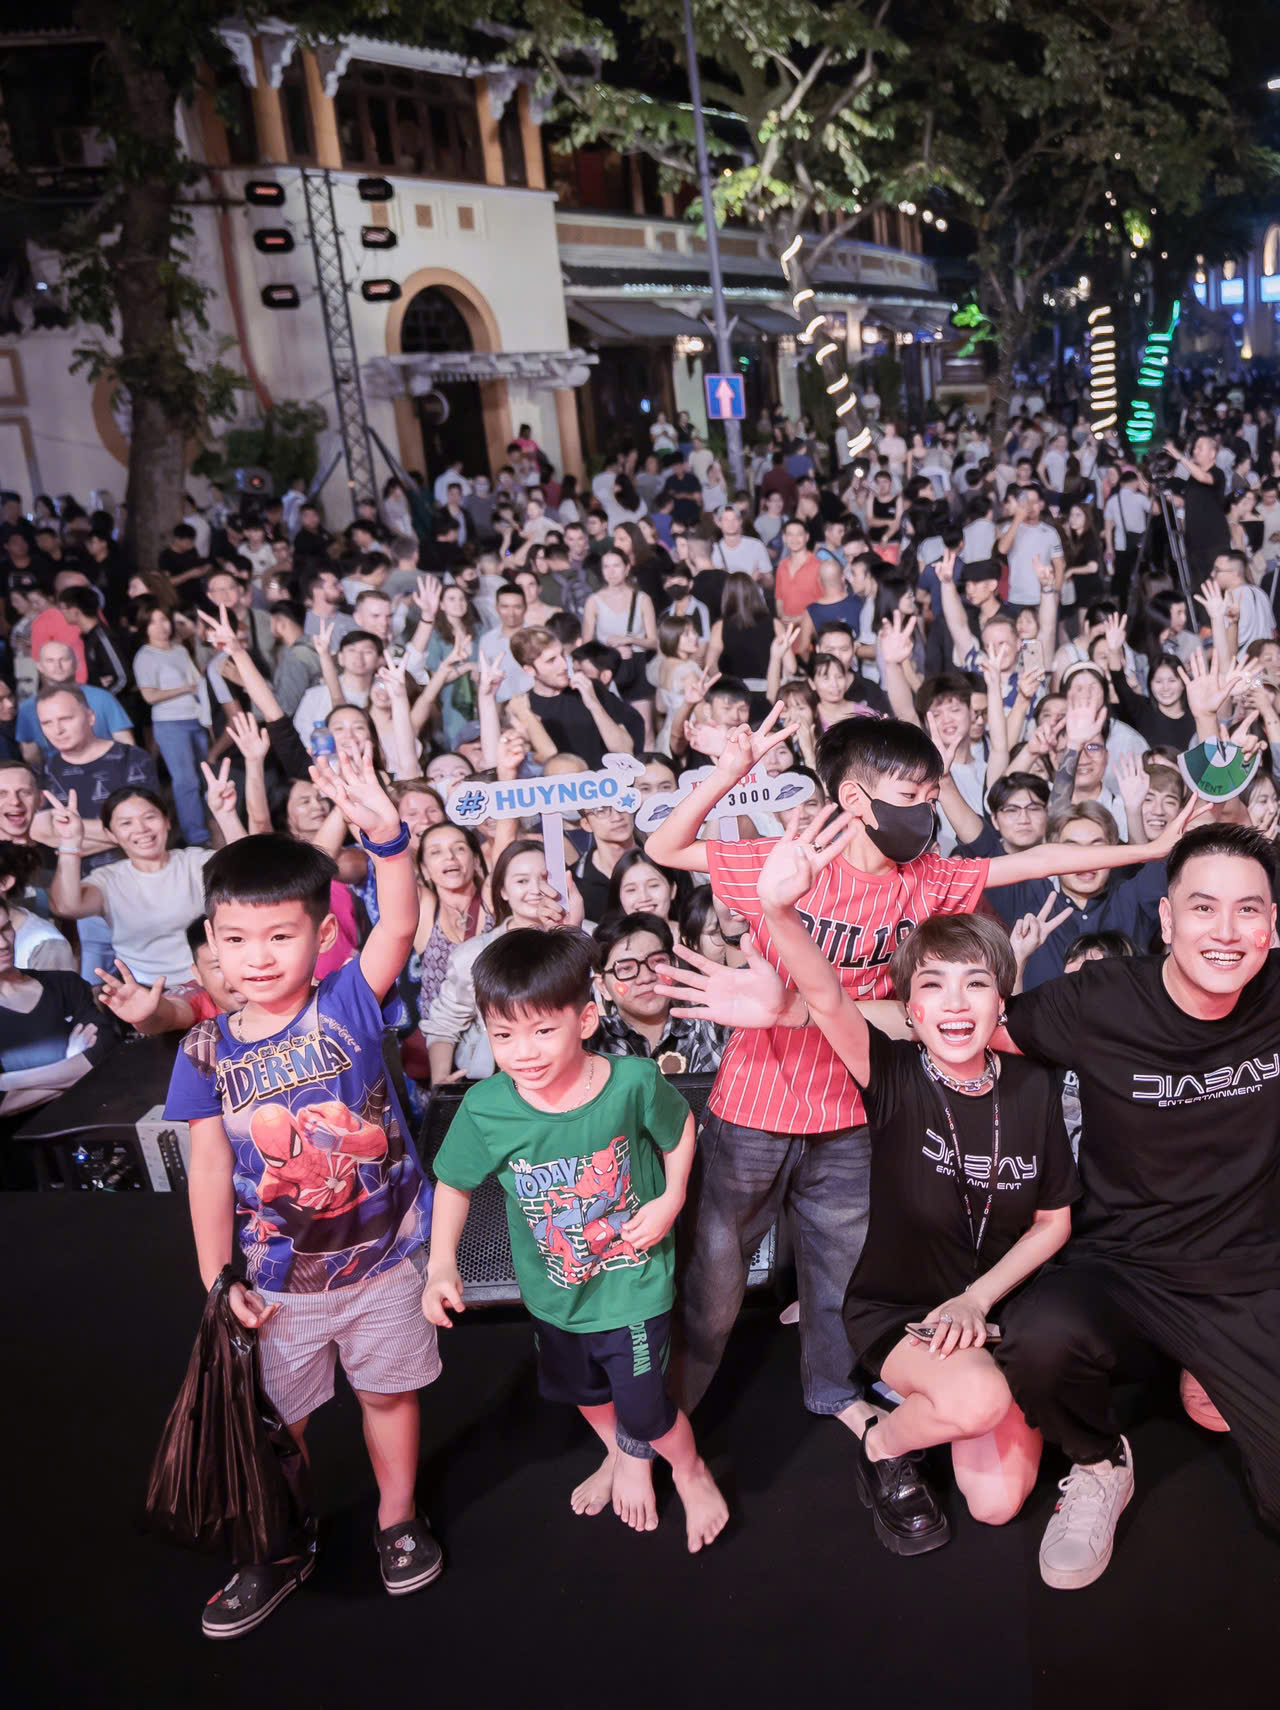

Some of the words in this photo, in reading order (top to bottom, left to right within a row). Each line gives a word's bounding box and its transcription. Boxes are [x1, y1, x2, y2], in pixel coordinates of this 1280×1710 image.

[728, 788, 770, 806] 3000
[1132, 1053, 1280, 1098] DIABAY
[1158, 1084, 1263, 1107] ENTERTAINMENT
[515, 1156, 580, 1198] TODAY
[628, 1321, 652, 1377] DER-MAN
